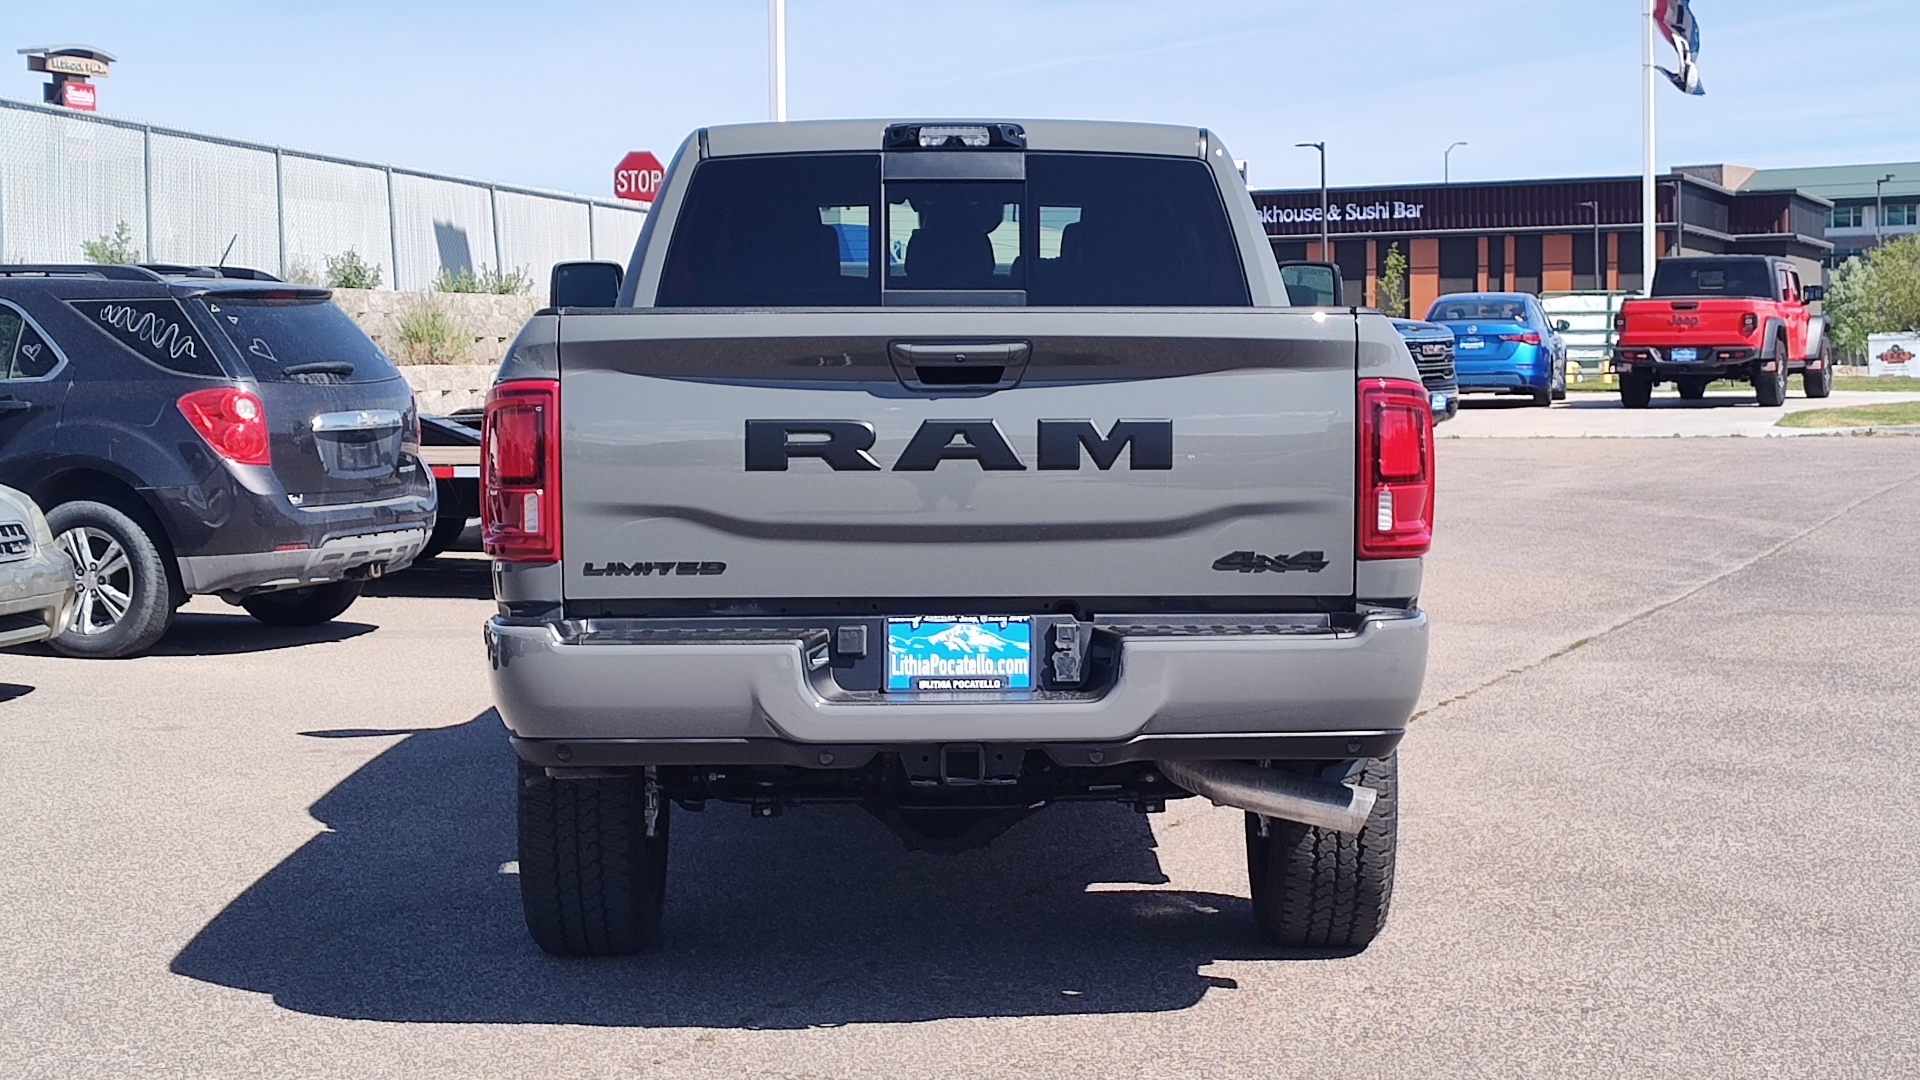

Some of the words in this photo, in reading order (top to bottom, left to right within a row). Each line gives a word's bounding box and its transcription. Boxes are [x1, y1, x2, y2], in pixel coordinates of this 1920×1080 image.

[616, 169, 663, 193] STOP
[1326, 204, 1342, 221] &
[1345, 201, 1389, 221] Sushi
[1393, 201, 1424, 219] Bar
[744, 418, 1174, 472] RAM
[582, 561, 727, 577] LIMITED
[890, 653, 1028, 676] LithiaPocatello.com
[953, 680, 1001, 689] POCATELLO
